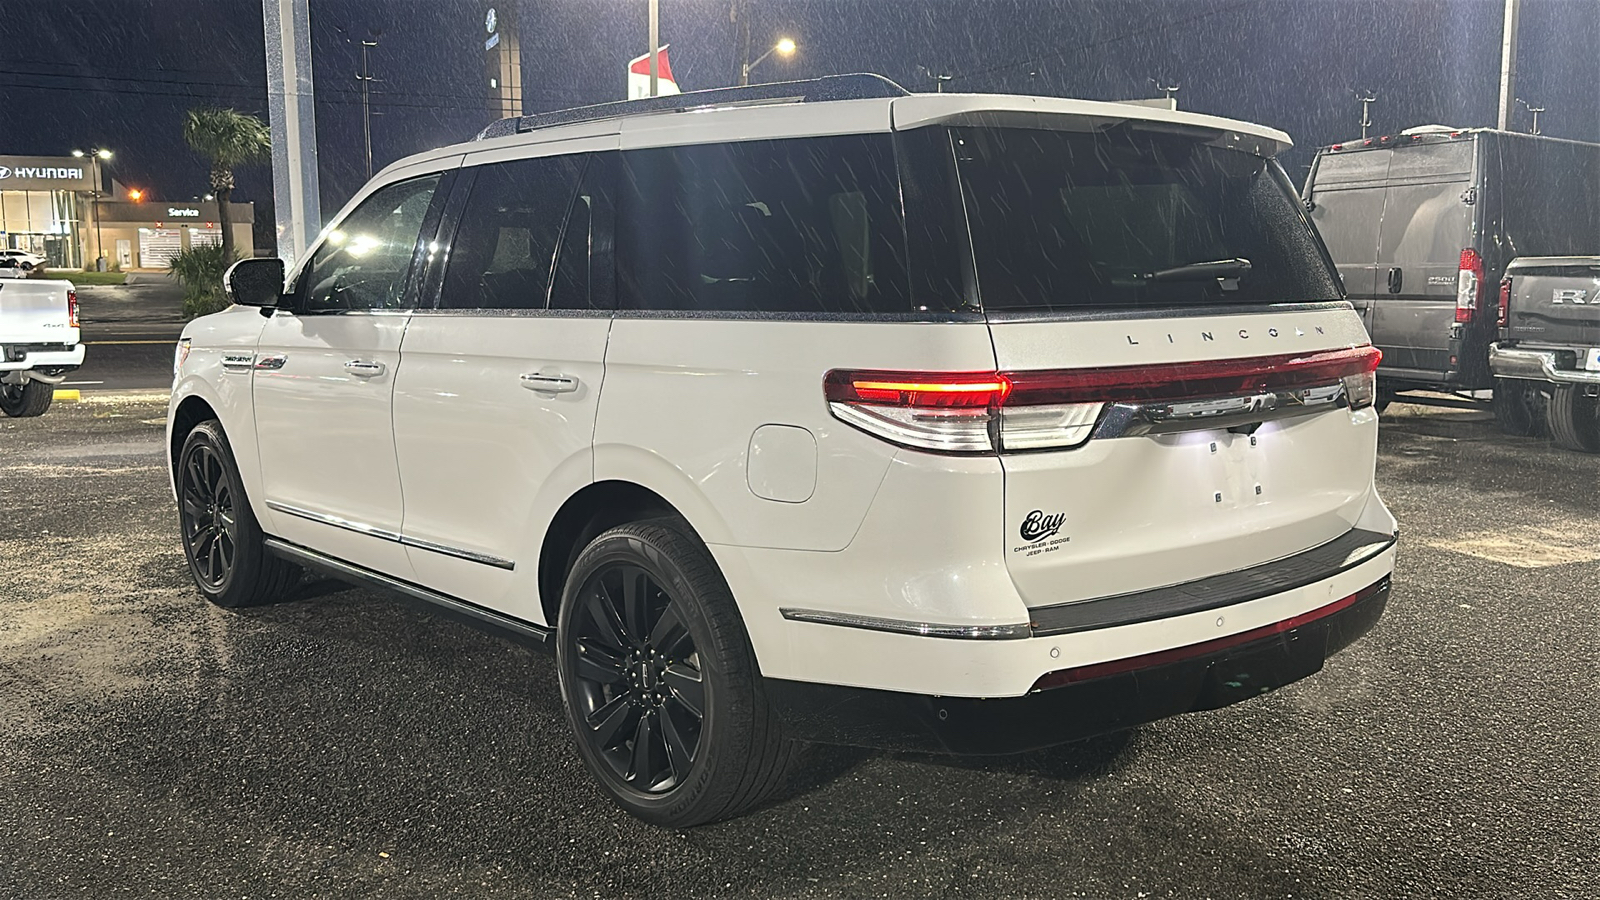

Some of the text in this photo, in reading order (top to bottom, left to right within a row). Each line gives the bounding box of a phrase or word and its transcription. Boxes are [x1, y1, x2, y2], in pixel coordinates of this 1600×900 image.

[15, 167, 83, 179] HYUNDAI
[168, 207, 199, 217] Service
[1127, 326, 1325, 346] LINCOLN
[1020, 510, 1067, 543] Bay
[1014, 536, 1071, 553] CHRYSLER DODGE
[1026, 545, 1060, 557] JEEP RAM
